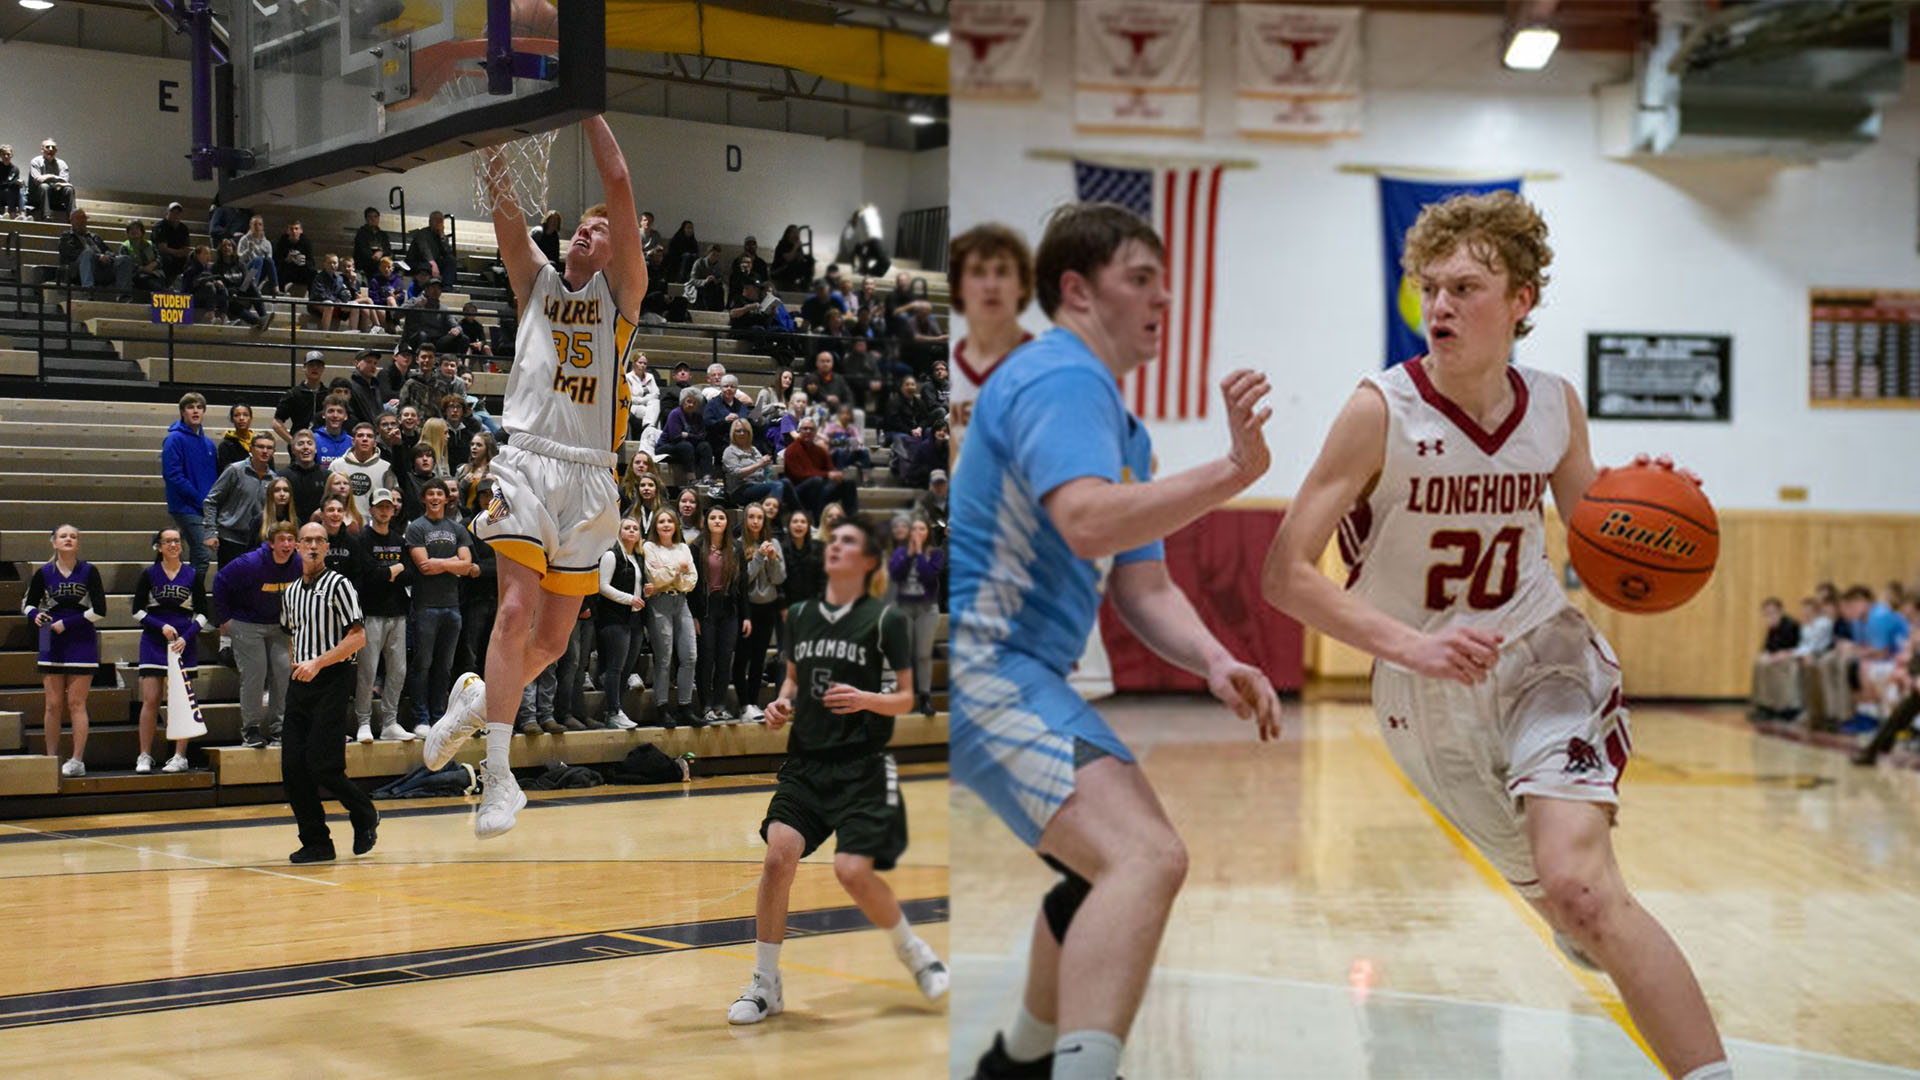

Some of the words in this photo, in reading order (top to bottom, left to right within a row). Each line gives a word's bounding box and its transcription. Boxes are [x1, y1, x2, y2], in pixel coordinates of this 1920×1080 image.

[159, 80, 179, 112] E
[726, 144, 742, 172] D
[152, 294, 191, 309] STUDENT
[160, 309, 184, 323] BODY
[553, 365, 598, 405] HGH
[1600, 511, 1698, 557] Baden
[1424, 525, 1525, 612] 20
[50, 582, 88, 598] LHS
[151, 584, 191, 600] LHS
[794, 638, 867, 666] COLUMBUS
[811, 667, 832, 700] 5
